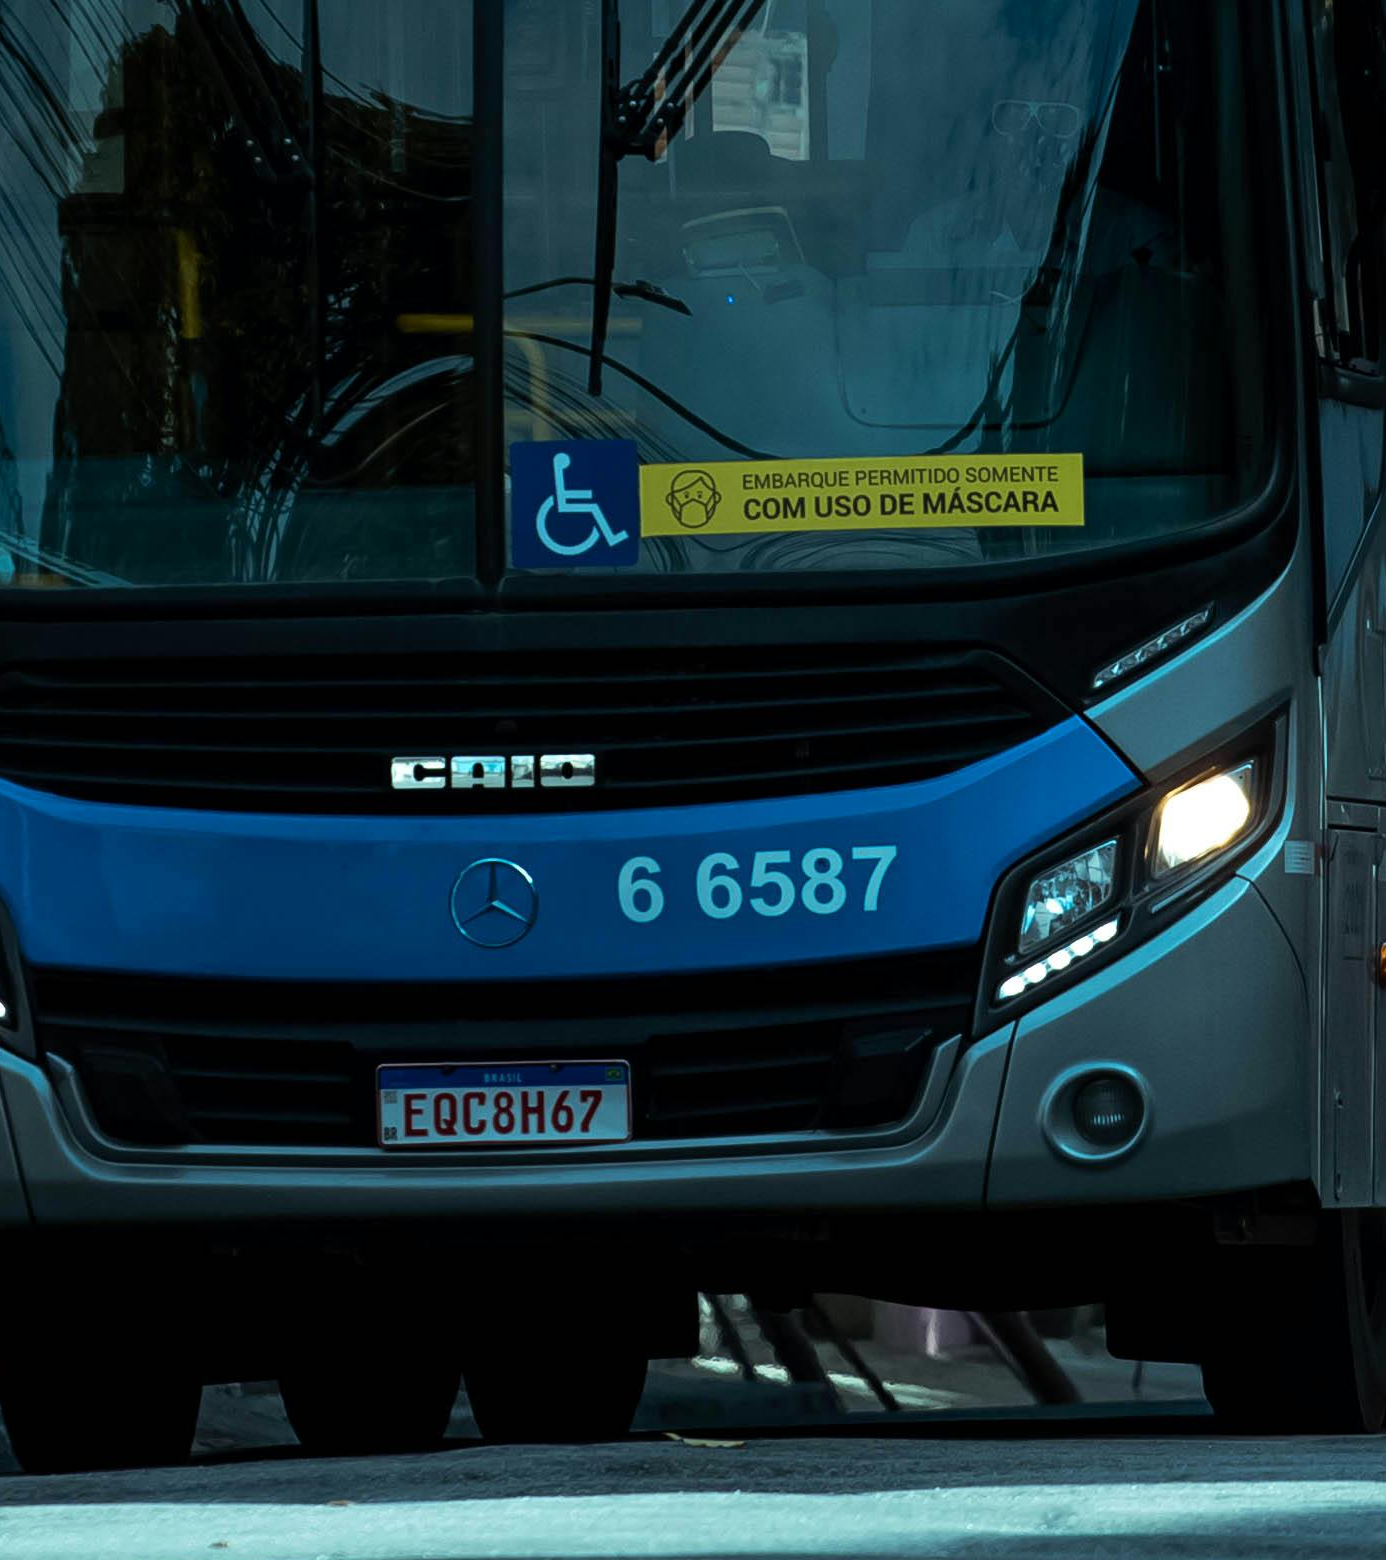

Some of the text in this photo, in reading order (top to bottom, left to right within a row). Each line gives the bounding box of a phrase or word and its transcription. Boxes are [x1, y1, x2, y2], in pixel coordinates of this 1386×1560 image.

[742, 466, 1059, 491] EMBARQUE PERMITIDO SOMENTE
[743, 487, 1059, 522] COM USO DE MÁSCARA
[391, 753, 595, 789] CAIO
[617, 844, 898, 923] 6 6587
[483, 1072, 523, 1084] BRASIL
[403, 1089, 603, 1138] EQC8H67
